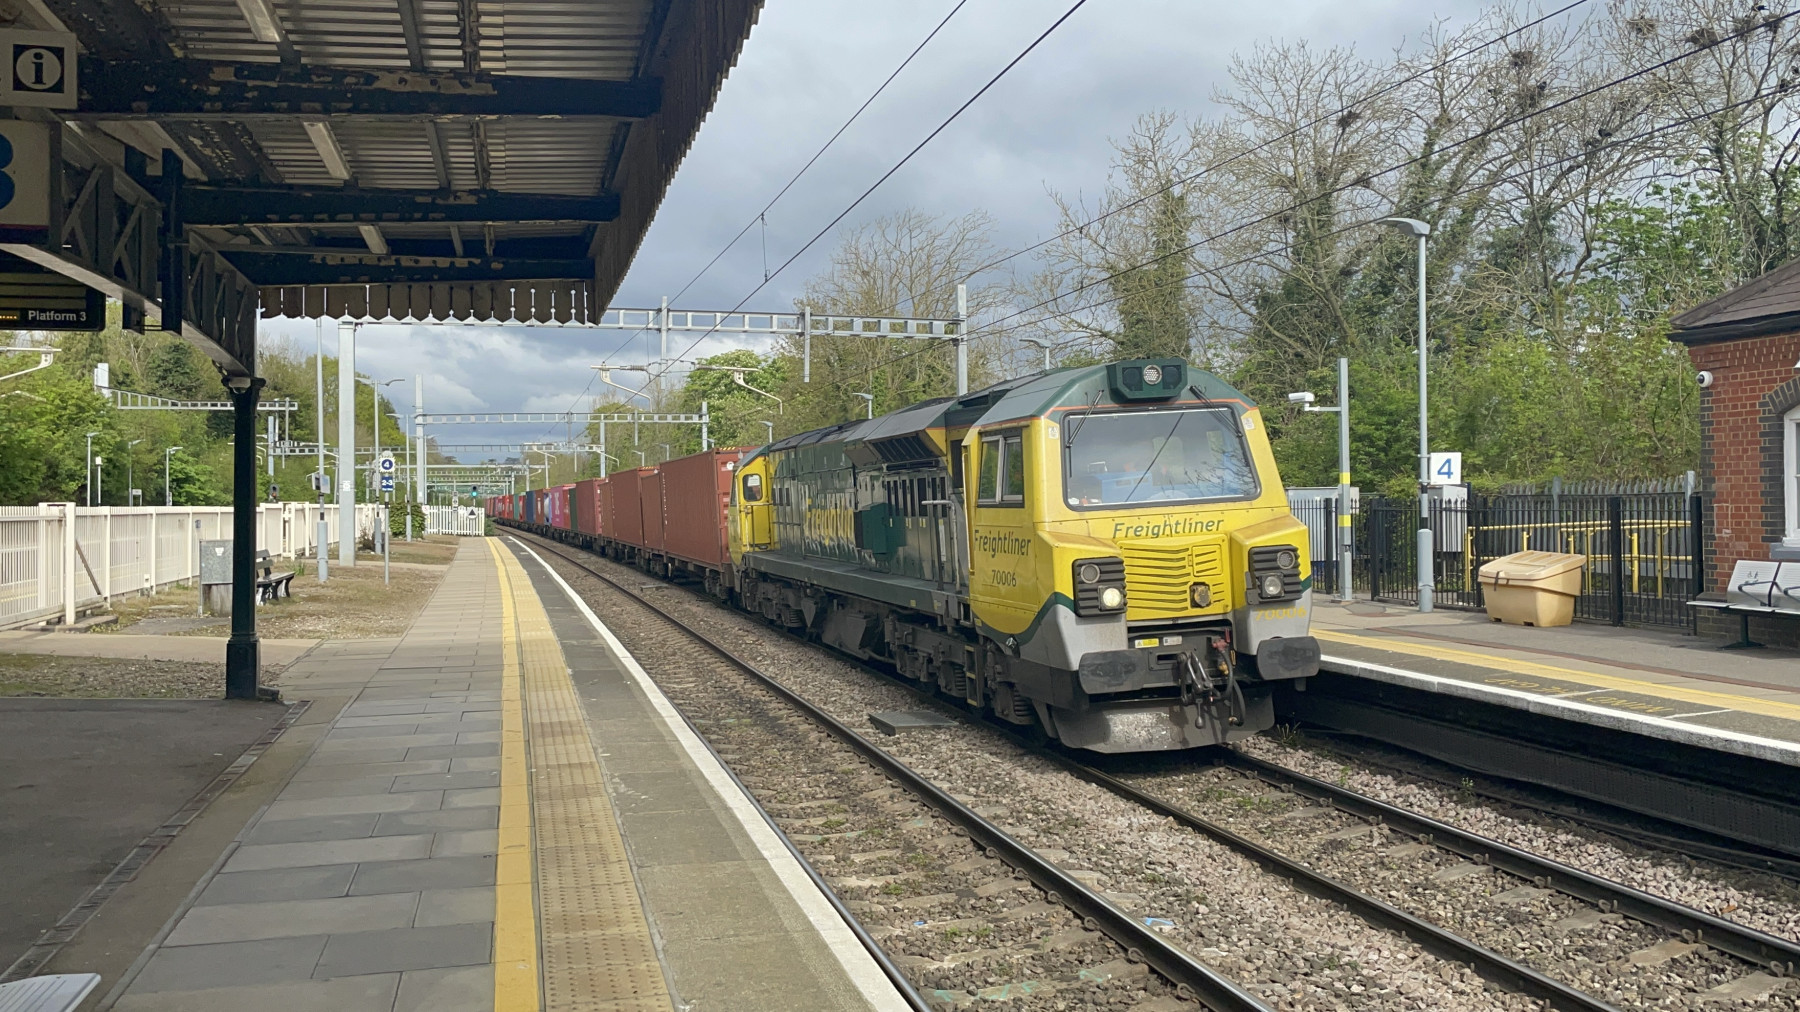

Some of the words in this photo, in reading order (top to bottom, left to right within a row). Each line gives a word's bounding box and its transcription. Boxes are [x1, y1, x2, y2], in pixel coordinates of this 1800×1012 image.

[28, 310, 77, 321] Platform
[80, 311, 87, 321] 3
[1437, 458, 1454, 479] 4
[1112, 518, 1224, 538] Freightliner
[974, 529, 1031, 558] Freightliner
[991, 569, 1017, 588] 70006
[1255, 606, 1307, 621] 70006
